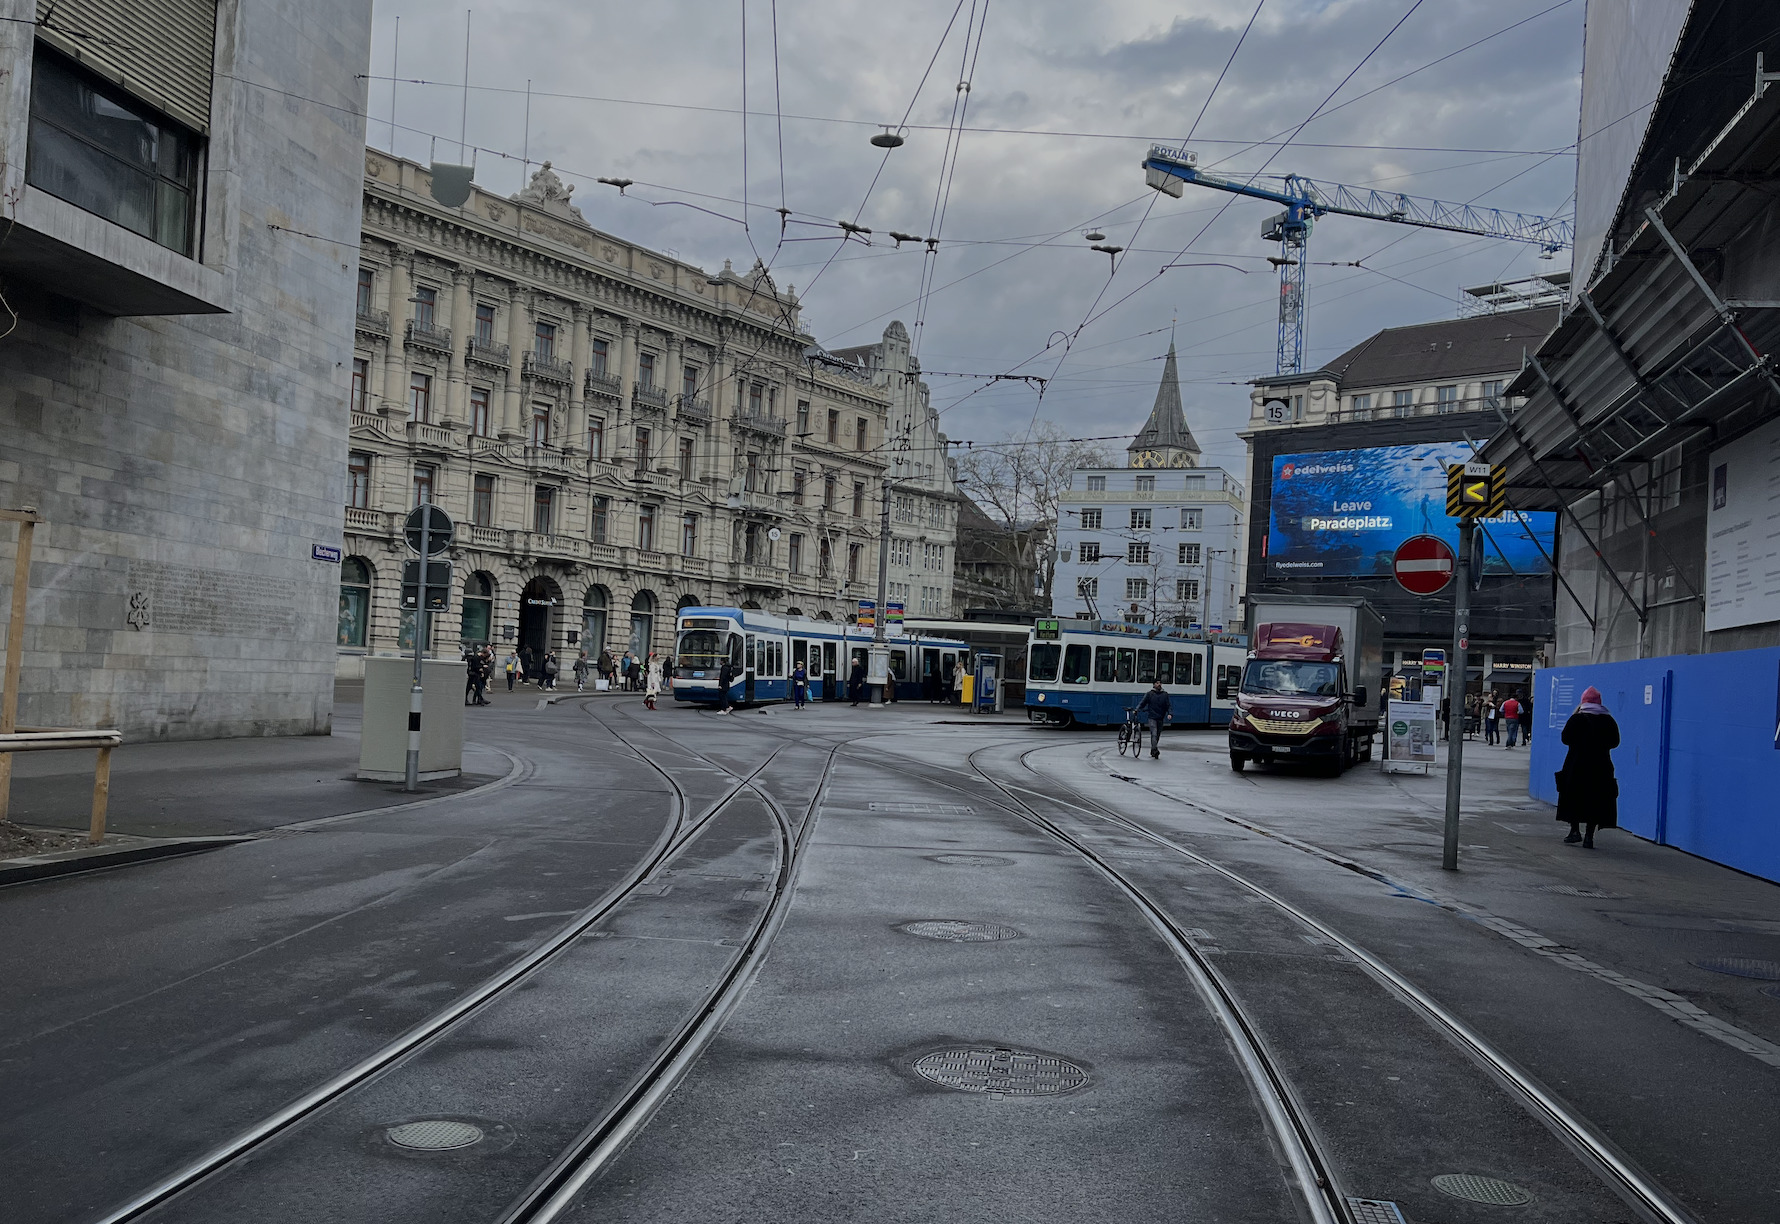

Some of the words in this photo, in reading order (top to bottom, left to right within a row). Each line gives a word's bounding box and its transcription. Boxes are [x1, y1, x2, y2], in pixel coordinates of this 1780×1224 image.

[1153, 146, 1188, 161] POTAIN
[1268, 407, 1283, 419] 15
[1294, 463, 1354, 475] edelweiss
[1469, 466, 1486, 474] W11
[1332, 500, 1372, 513] Leave
[1310, 516, 1393, 531] Paradeplatz.
[1275, 561, 1324, 569] flyedelweiss.com
[1045, 620, 1051, 630] 8
[1270, 710, 1300, 719] IVECO
